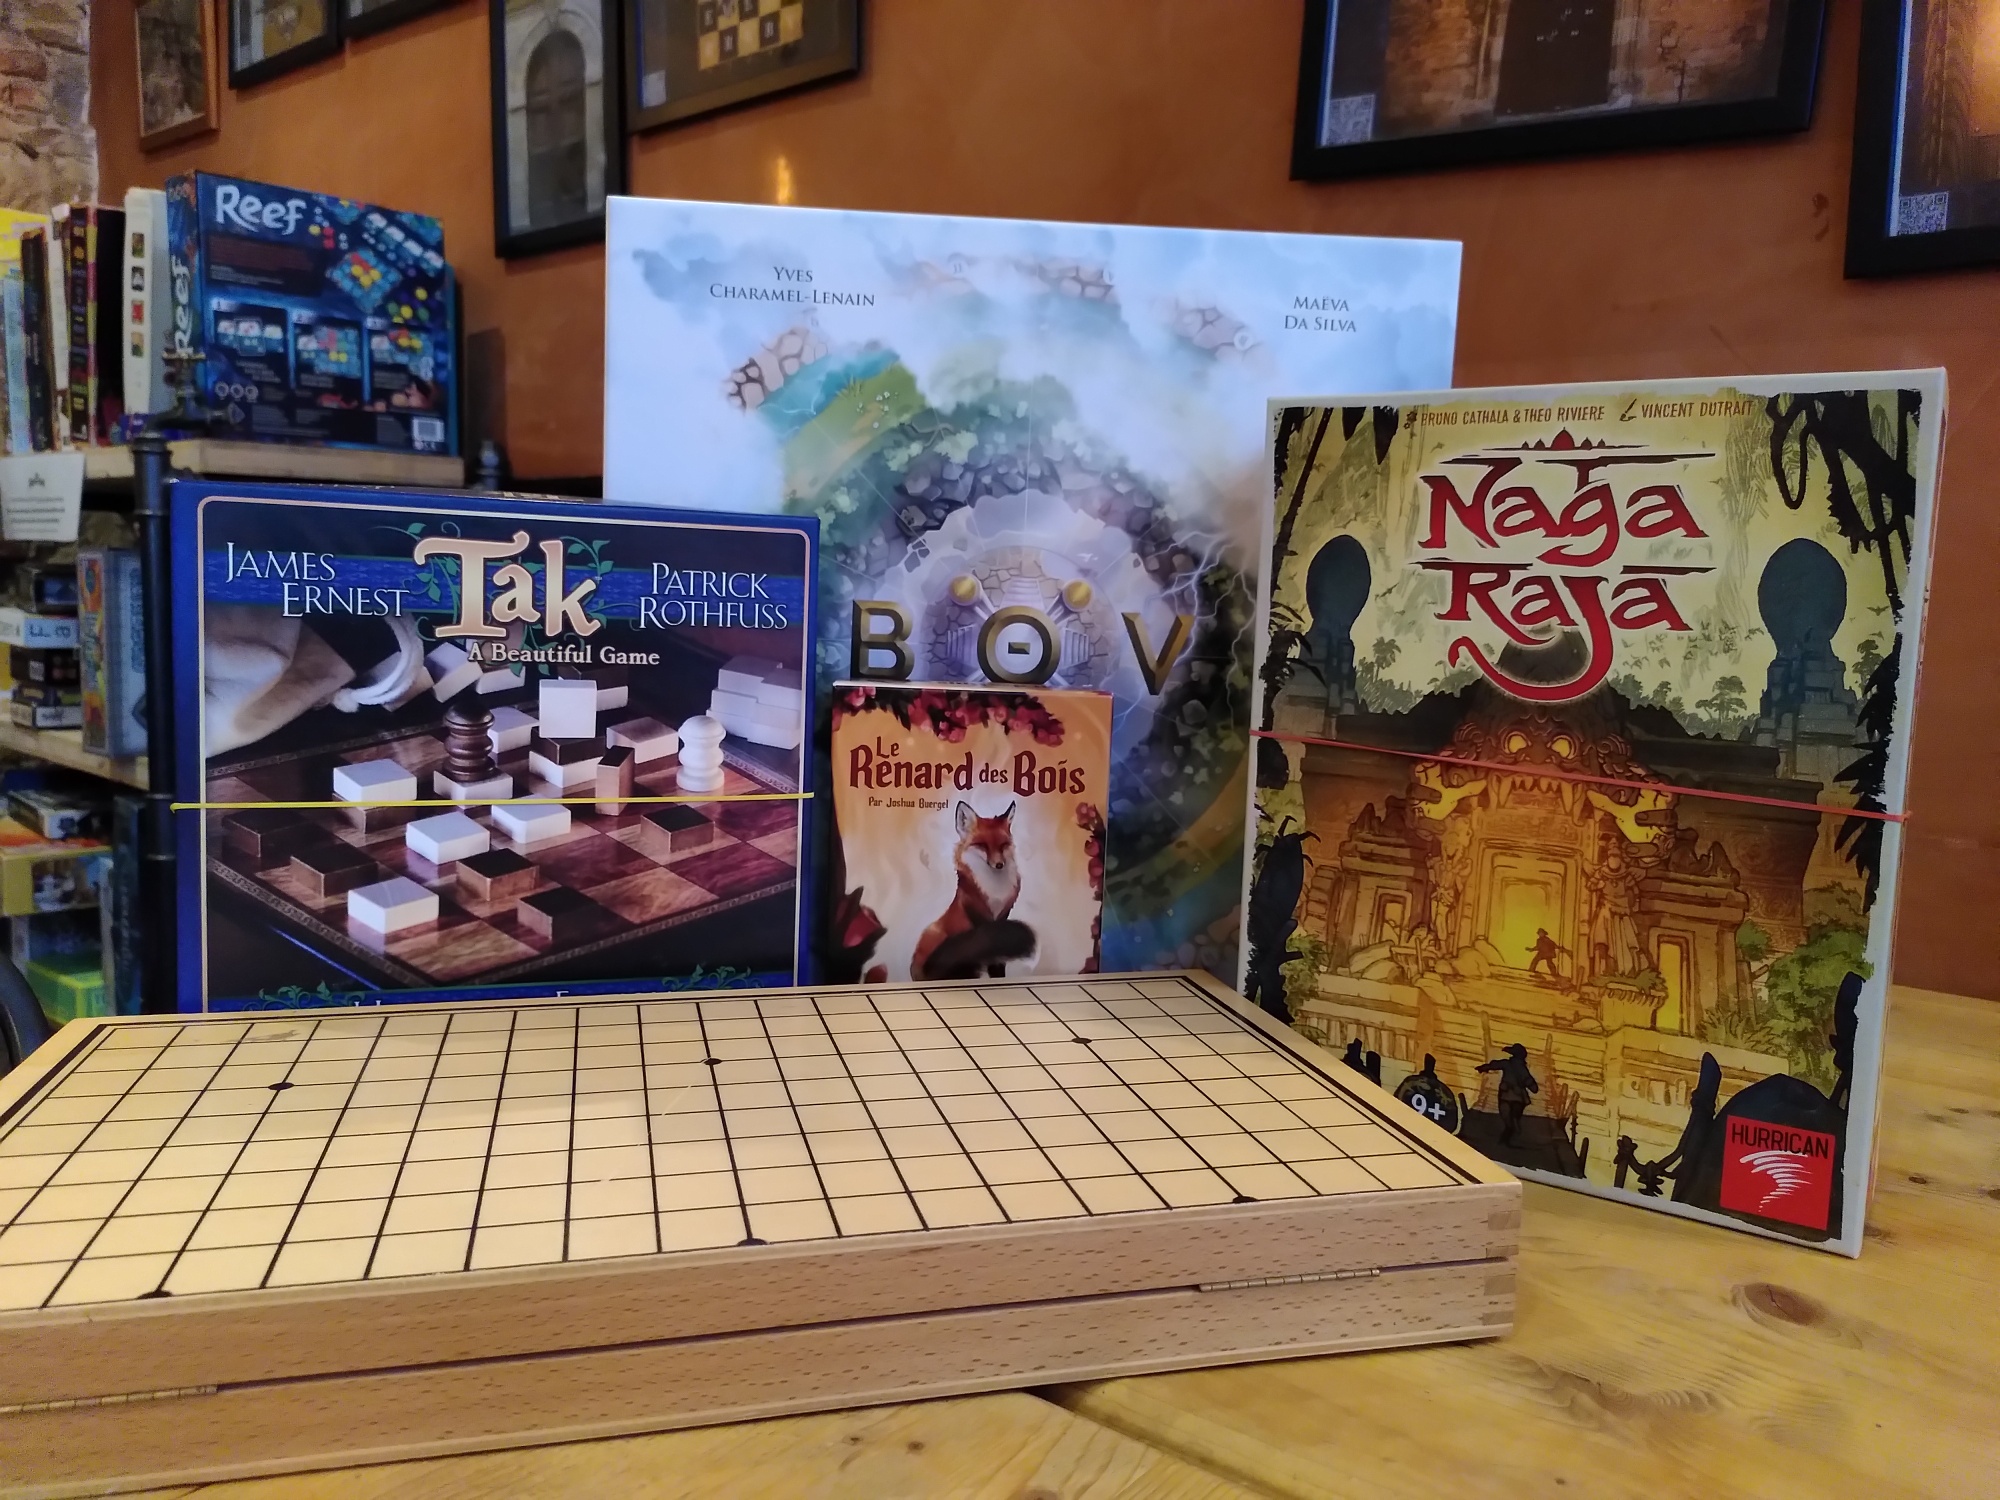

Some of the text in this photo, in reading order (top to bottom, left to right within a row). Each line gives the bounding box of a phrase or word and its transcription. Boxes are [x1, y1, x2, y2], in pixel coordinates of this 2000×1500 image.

[215, 184, 307, 236] Reef
[170, 254, 195, 356] Reef
[1421, 406, 1605, 427] BRUNO CATHALA & THEO RIVIERE
[1641, 400, 1754, 418] VINCENT DUTRAIT
[226, 542, 336, 583] JAMES
[414, 531, 602, 638] Tak
[650, 562, 770, 600] PATRICK
[282, 582, 410, 618] ERNEST
[639, 596, 788, 630] ROTHFUSS
[468, 643, 660, 666] A Beautiful Game
[876, 736, 900, 758] Le
[849, 744, 1086, 797] Renard des Bois
[868, 796, 949, 811] Par Joshua Buergel
[1411, 1093, 1446, 1120] 9+
[1731, 1123, 1829, 1159] HURRICAN
